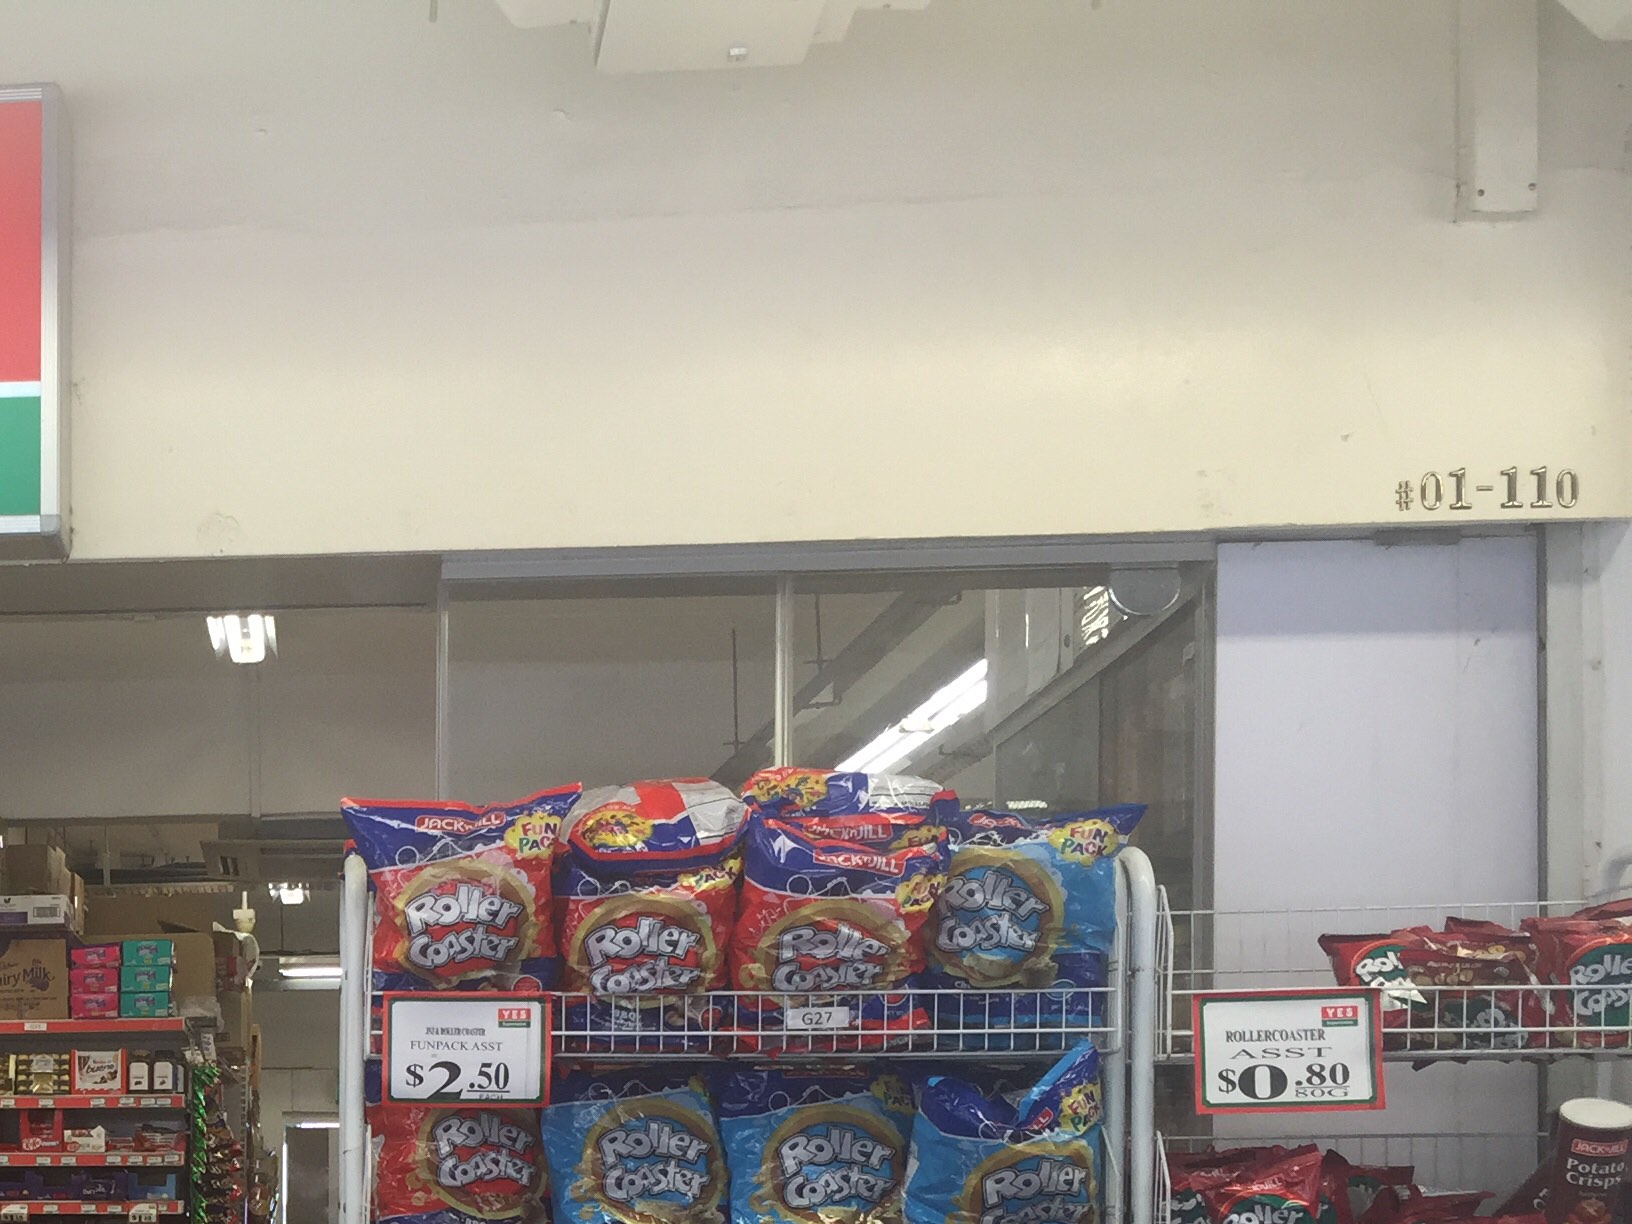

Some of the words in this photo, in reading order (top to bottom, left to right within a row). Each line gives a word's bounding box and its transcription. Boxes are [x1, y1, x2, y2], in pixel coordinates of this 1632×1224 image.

[1396, 466, 1579, 511] #01-110
[521, 822, 557, 836] FUN
[1069, 827, 1108, 843] FUN
[1062, 837, 1108, 856] PACK
[404, 883, 524, 934] Roller
[942, 870, 1050, 917] Roller
[409, 929, 519, 969] Coaster
[585, 916, 702, 966] Roller
[936, 914, 1041, 953] Coaster
[23, 966, 54, 981] Milk
[589, 956, 702, 997] Coaster
[772, 962, 884, 993] Coaster
[502, 1010, 527, 1019] YES
[801, 1011, 834, 1026] G27
[1326, 1008, 1353, 1017] YES
[410, 1041, 468, 1050] FUNPACK
[470, 1042, 503, 1051] ASST
[1226, 1029, 1326, 1042] ROLLERCOASTER
[85, 1063, 115, 1074] bueno
[1230, 1047, 1332, 1059] ASST
[406, 1061, 510, 1099] $2.50
[1218, 1063, 1350, 1100] $0.80
[1295, 1088, 1349, 1098] 80G
[1068, 1090, 1097, 1116] FUN
[1070, 1105, 1101, 1131] PACK
[432, 1112, 537, 1158] Roller
[599, 1120, 712, 1167] Roller
[778, 1127, 896, 1177] Roller
[1567, 1157, 1625, 1174] Potato
[436, 1152, 537, 1188] Coaster
[604, 1160, 712, 1202] Coaster
[984, 1158, 1089, 1207] Roller
[1566, 1172, 1622, 1190] Crisps
[783, 1165, 897, 1208] Coaster
